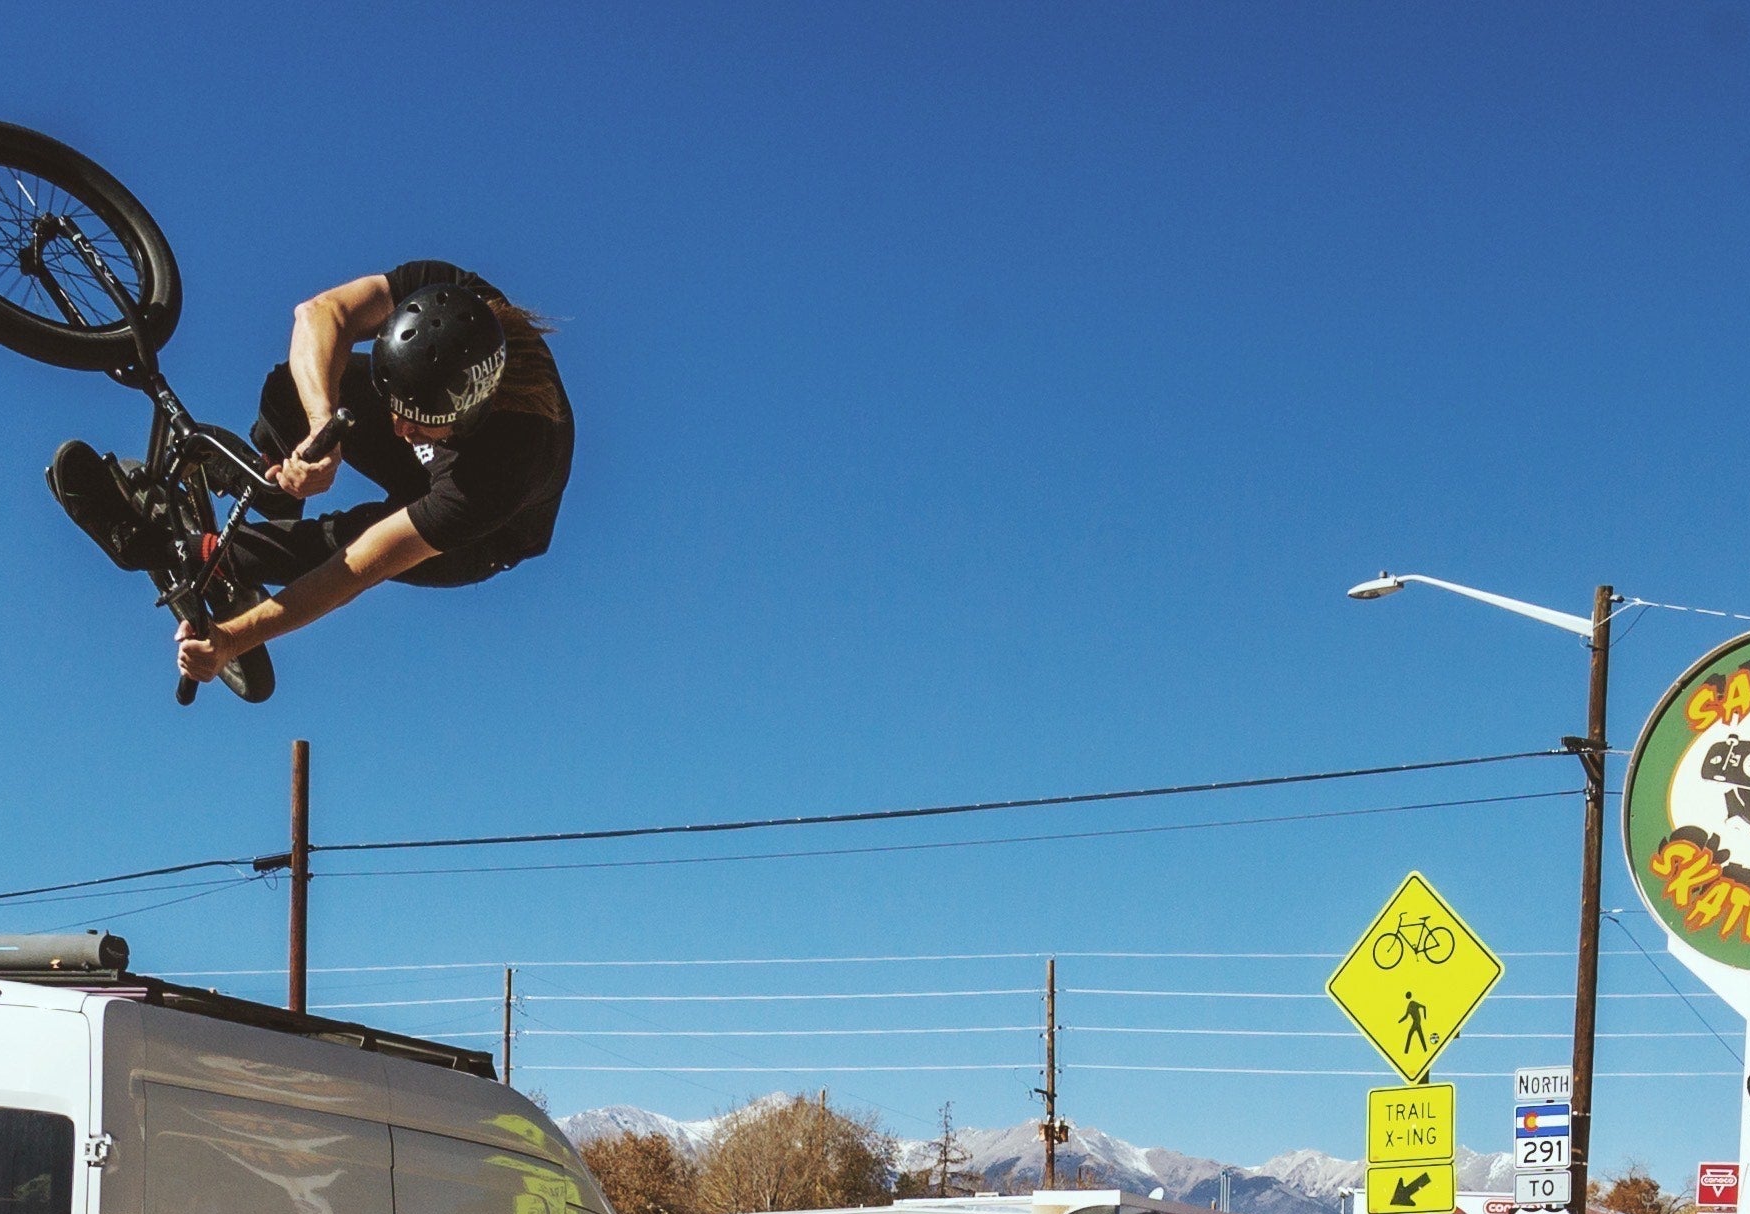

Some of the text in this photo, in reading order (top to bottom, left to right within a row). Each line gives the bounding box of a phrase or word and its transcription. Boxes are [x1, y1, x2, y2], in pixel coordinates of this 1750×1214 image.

[1518, 1074, 1570, 1095] NORTH
[1385, 1102, 1437, 1122] TRAIL
[1385, 1127, 1437, 1148] X-ING
[1523, 1140, 1563, 1164] 291
[1529, 1180, 1555, 1197] TO
